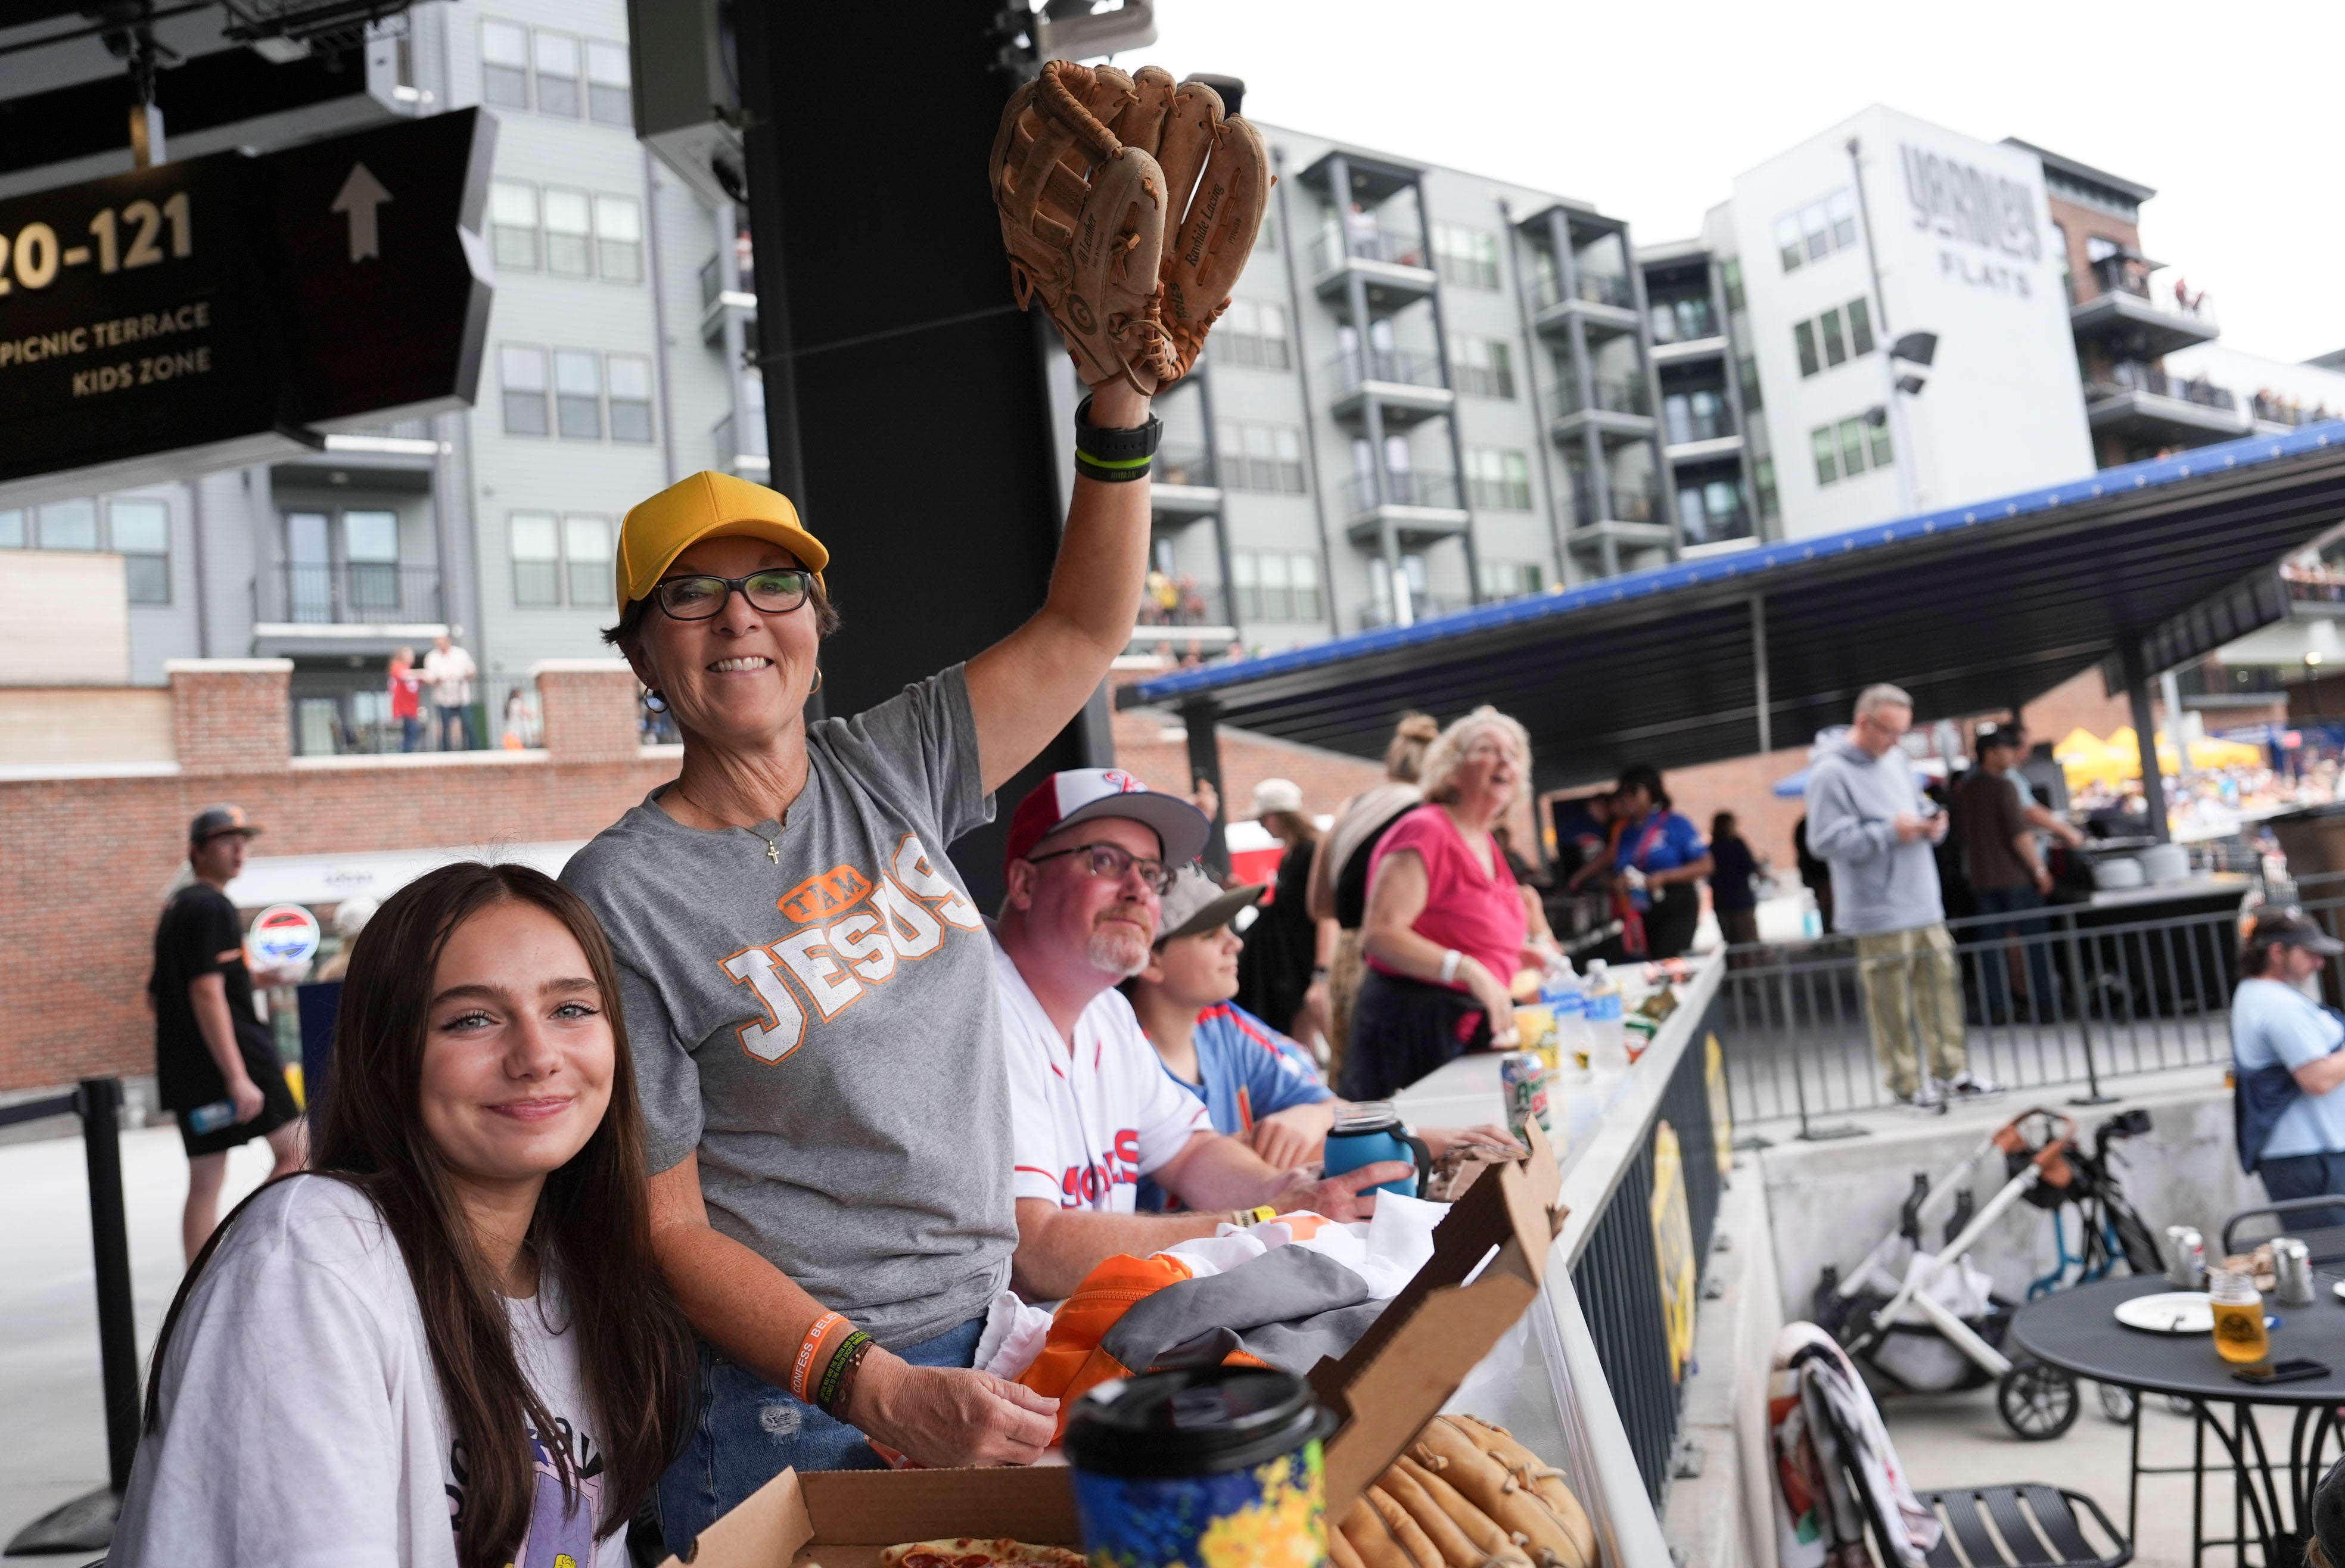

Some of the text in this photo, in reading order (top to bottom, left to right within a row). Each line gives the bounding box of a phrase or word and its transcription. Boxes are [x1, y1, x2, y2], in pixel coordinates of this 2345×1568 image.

[0, 191, 192, 295] 0-121
[1080, 212, 1096, 254] Leather
[1184, 183, 1224, 267] Rawhide Lacing
[0, 300, 210, 368] PICNIC TERRACE
[71, 345, 212, 398] KIDS ZONE
[718, 833, 986, 1066] JESUS
[793, 1342, 813, 1393] CONFESS
[834, 1348, 845, 1361] TRUTH
[842, 1340, 851, 1349] AND
[835, 1357, 847, 1373] FATHER
[843, 1344, 856, 1358] EXCEPT
